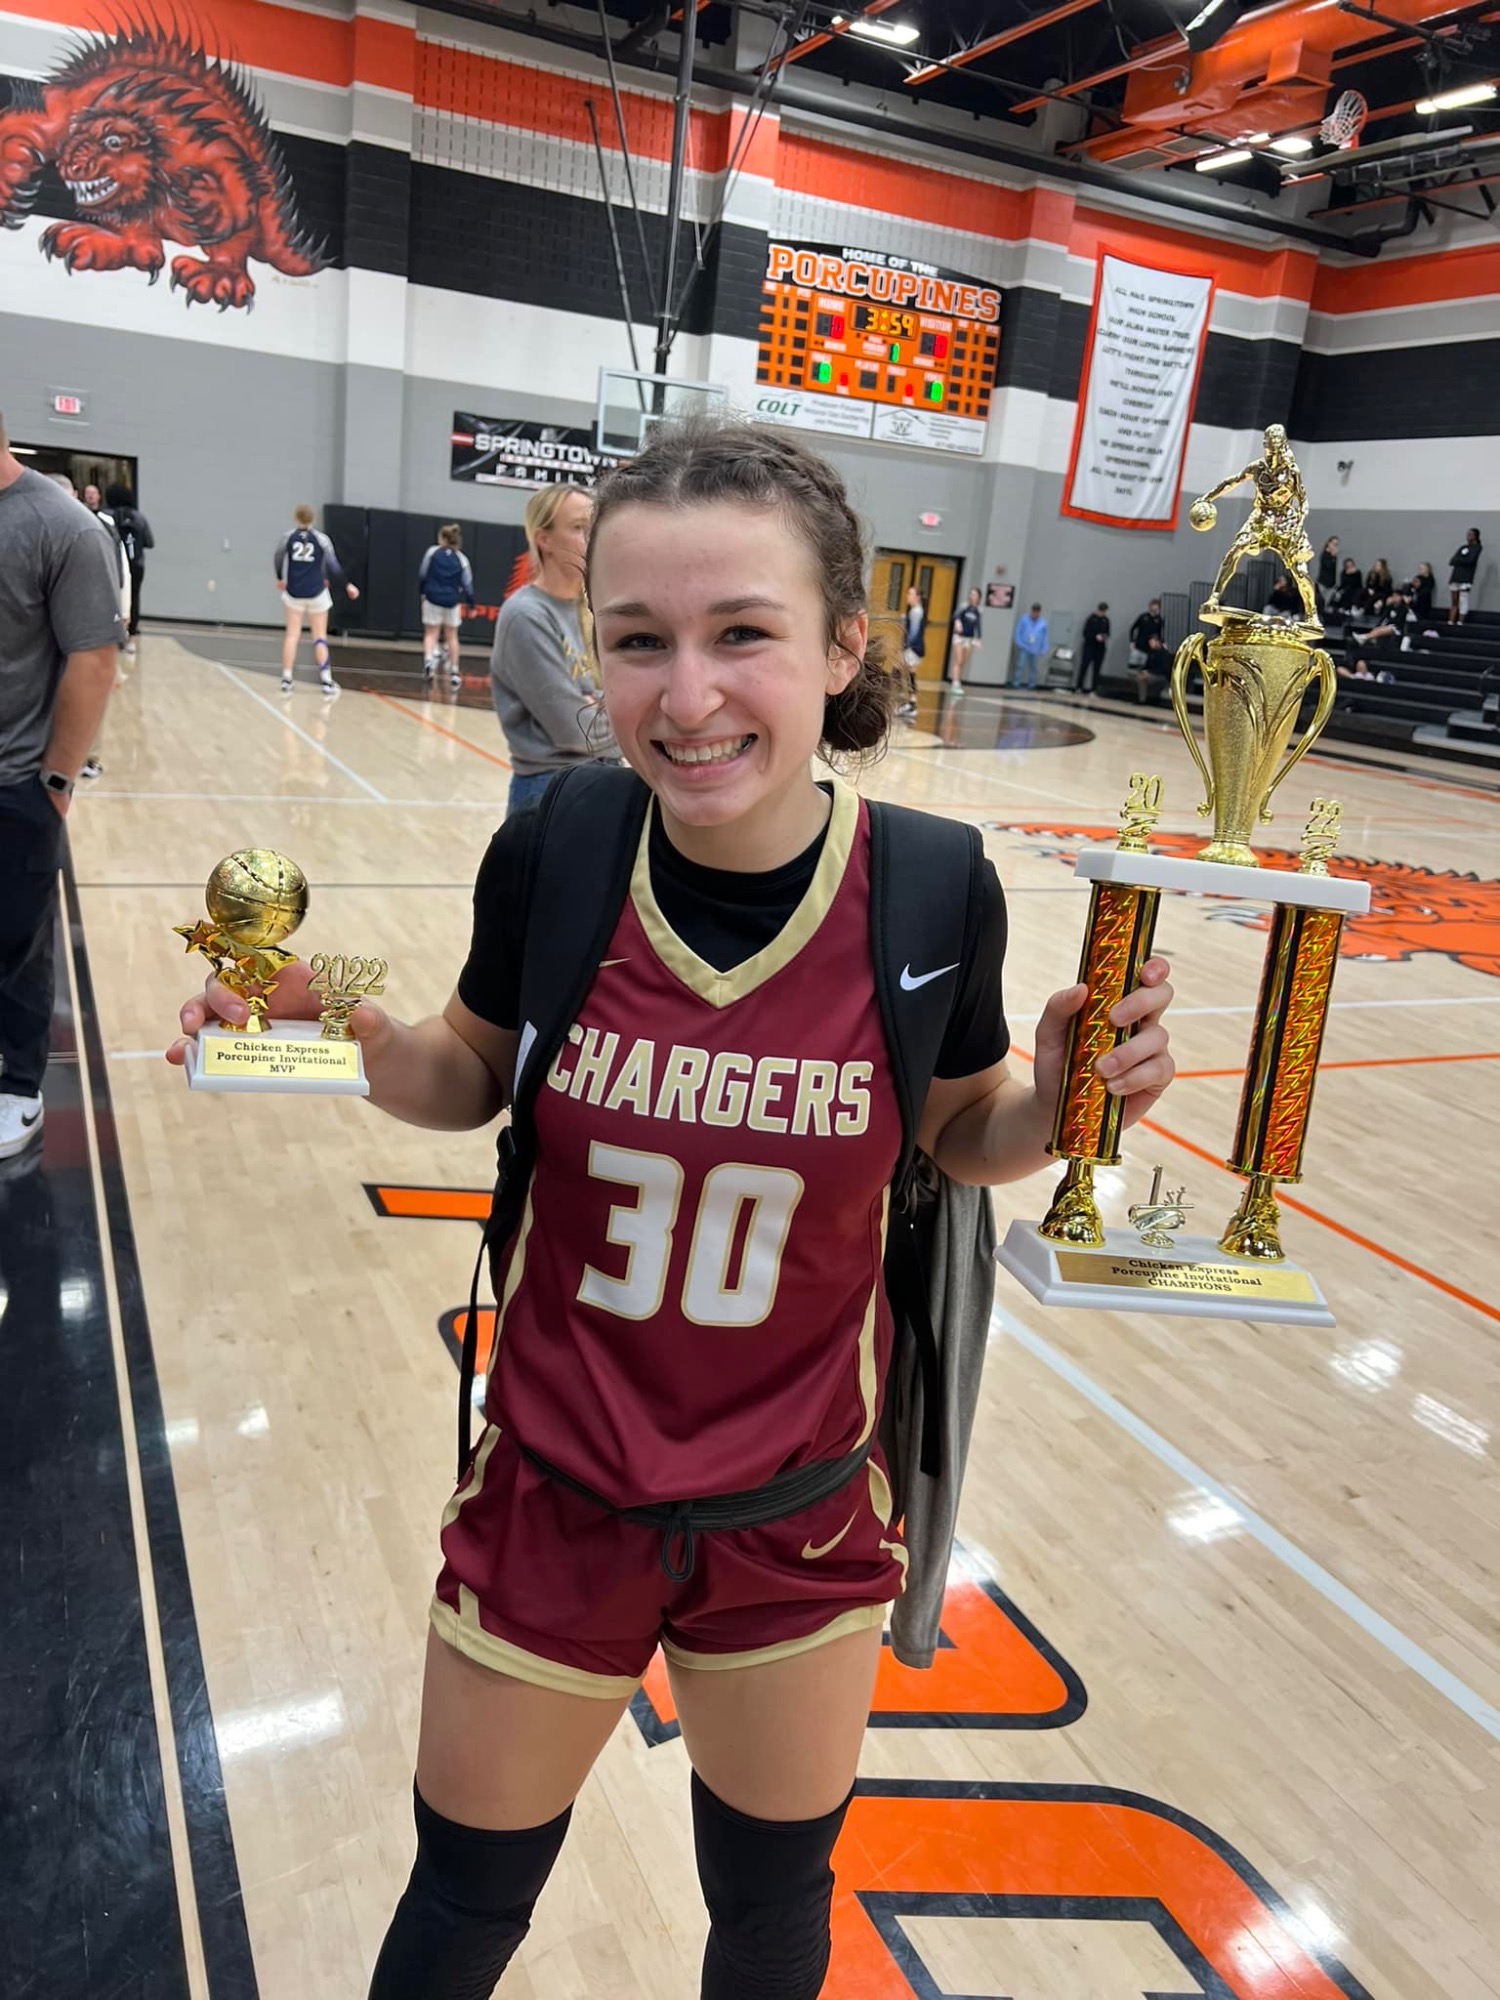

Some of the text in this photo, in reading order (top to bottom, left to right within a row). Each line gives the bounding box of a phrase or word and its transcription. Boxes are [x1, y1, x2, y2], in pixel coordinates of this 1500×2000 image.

[842, 248, 939, 278] HOME OF THE
[767, 244, 1000, 322] PORCUPINES
[865, 307, 914, 336] 3:59
[757, 399, 803, 416] COLT
[496, 463, 597, 487] FAMILY
[292, 541, 316, 562] 22
[1125, 772, 1164, 809] 20
[1306, 797, 1345, 834] 22
[308, 953, 388, 996] 2022
[217, 1051, 347, 1066] Porcupine Invitational
[234, 1042, 330, 1056] Chicken Express
[270, 1064, 296, 1073] MVP
[546, 1023, 874, 1137] CHARGERS
[576, 1140, 805, 1327] 30
[1111, 1266, 1262, 1286] Porcupine Invitational
[1129, 1259, 1240, 1276] Chicken Express
[1148, 1278, 1232, 1292] CHAMPIONS
